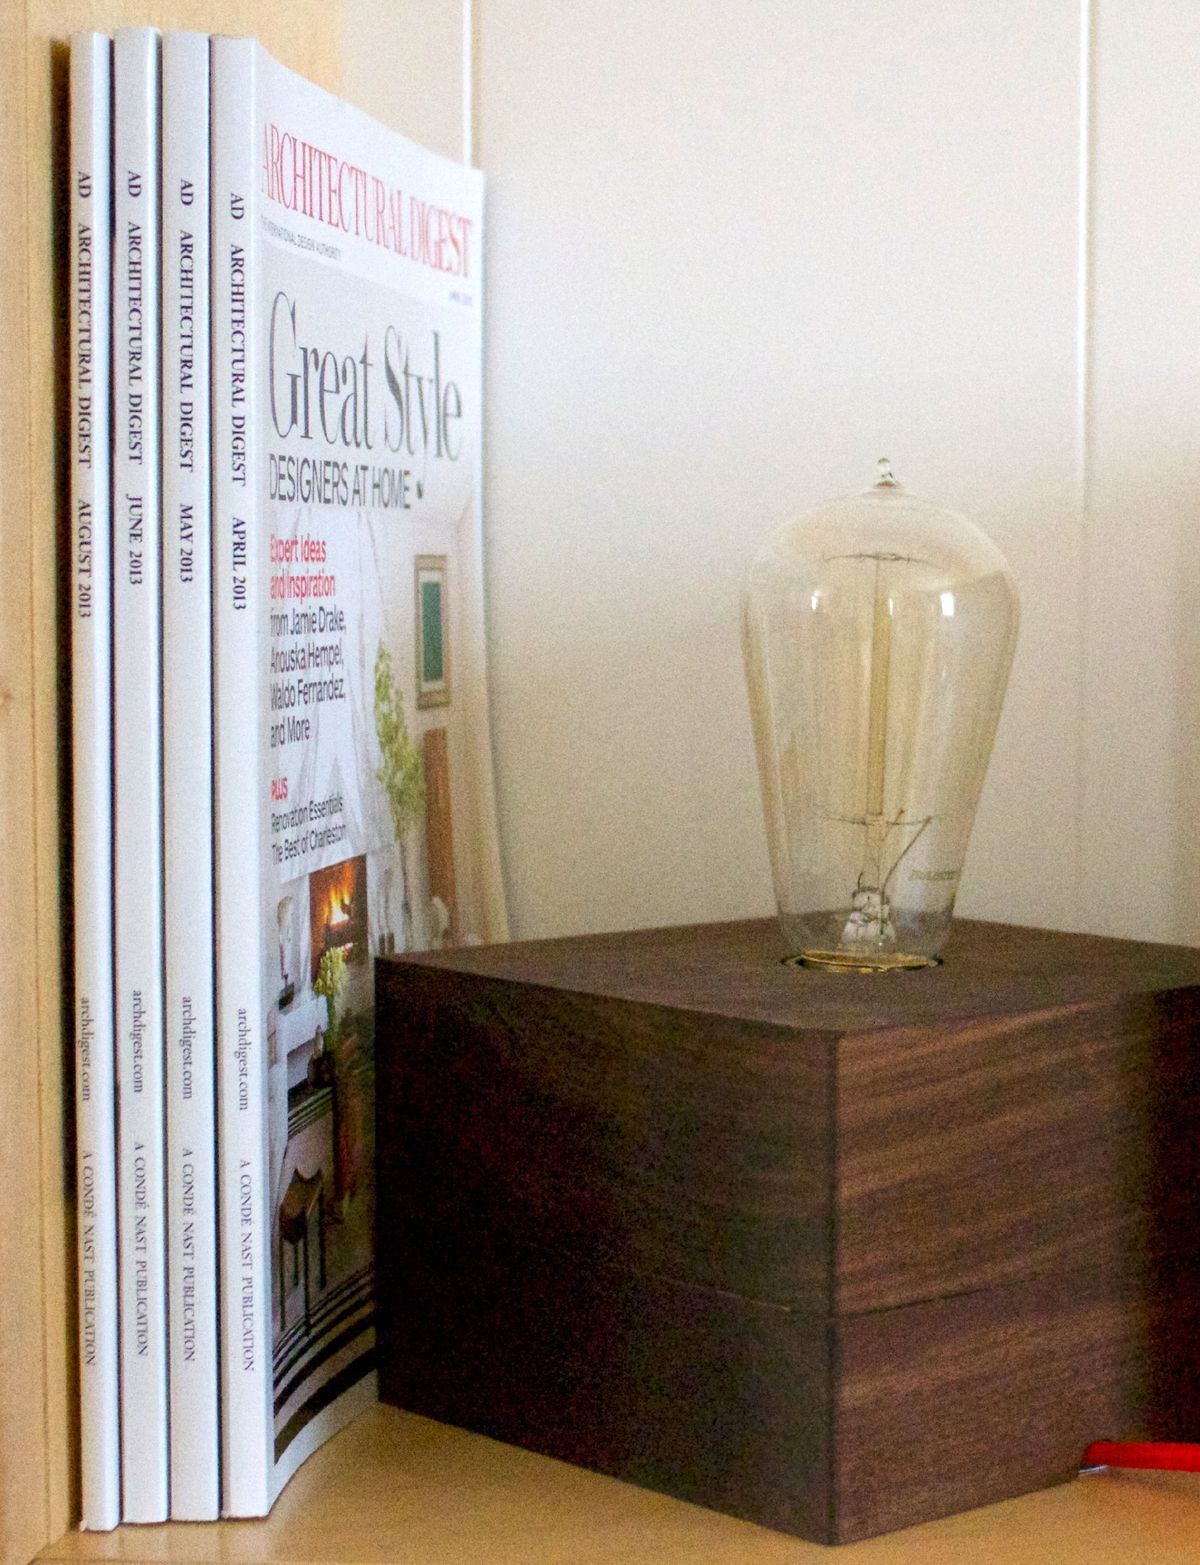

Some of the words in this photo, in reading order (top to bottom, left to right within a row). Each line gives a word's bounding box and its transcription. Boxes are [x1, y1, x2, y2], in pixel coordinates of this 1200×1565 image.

[77, 171, 92, 198] AD
[127, 170, 143, 198] AD
[179, 179, 194, 206] AD
[230, 193, 246, 220] AD
[261, 123, 406, 257] ARCHITECTURAL
[409, 196, 473, 278] DIGEST
[77, 223, 92, 389] ARCHITECTURAL
[127, 221, 143, 386] ARCHITECTURAL
[179, 230, 194, 394] ARCHITECTURAL
[230, 244, 246, 408] ARCHITECTURAL
[269, 291, 373, 450] Great
[384, 325, 462, 499] Style
[77, 396, 92, 469] DIGEST
[127, 393, 143, 465] DIGEST
[179, 401, 194, 473] DIGEST
[230, 415, 246, 487] DIGEST
[269, 453, 349, 506] DESIGNERS
[352, 465, 369, 506] AT
[372, 465, 411, 509] HOME
[77, 498, 92, 578] AUGUST
[127, 493, 143, 543] JUNE
[179, 503, 194, 543] MAY
[230, 516, 246, 571] APRIL
[127, 549, 143, 585] 2013
[179, 548, 194, 583] 2013
[300, 533, 327, 562] Ideas
[77, 583, 92, 618] 2013
[230, 576, 246, 611] 2013
[270, 568, 285, 599] and
[290, 606, 316, 635] Jamie
[318, 604, 347, 635] Drake,
[270, 678, 296, 711] Waldo
[297, 673, 346, 706] Fernandez,
[270, 716, 286, 748] and
[287, 716, 310, 743] More
[78, 998, 94, 1100] archdigest.com
[129, 990, 146, 1093] archdigest.com
[178, 997, 196, 1099] archdigest.com
[233, 1009, 252, 1111] archdigest.com
[83, 1150, 93, 1159] A
[135, 1142, 145, 1151] A
[182, 1148, 194, 1158] A
[239, 1159, 250, 1169] A
[83, 1166, 96, 1217] CONDÉ
[134, 1157, 149, 1209] CONDÉ
[182, 1164, 195, 1215] CONDÉ
[240, 1175, 254, 1226] CONDÉ
[84, 1225, 96, 1262] NAST
[135, 1216, 147, 1252] NAST
[183, 1222, 195, 1260] NAST
[241, 1233, 253, 1268] NAST
[84, 1270, 97, 1366] PUBLICATION
[136, 1261, 149, 1357] PUBLICATION
[183, 1267, 196, 1362] PUBLICATION
[242, 1277, 255, 1372] PUBLICATION
